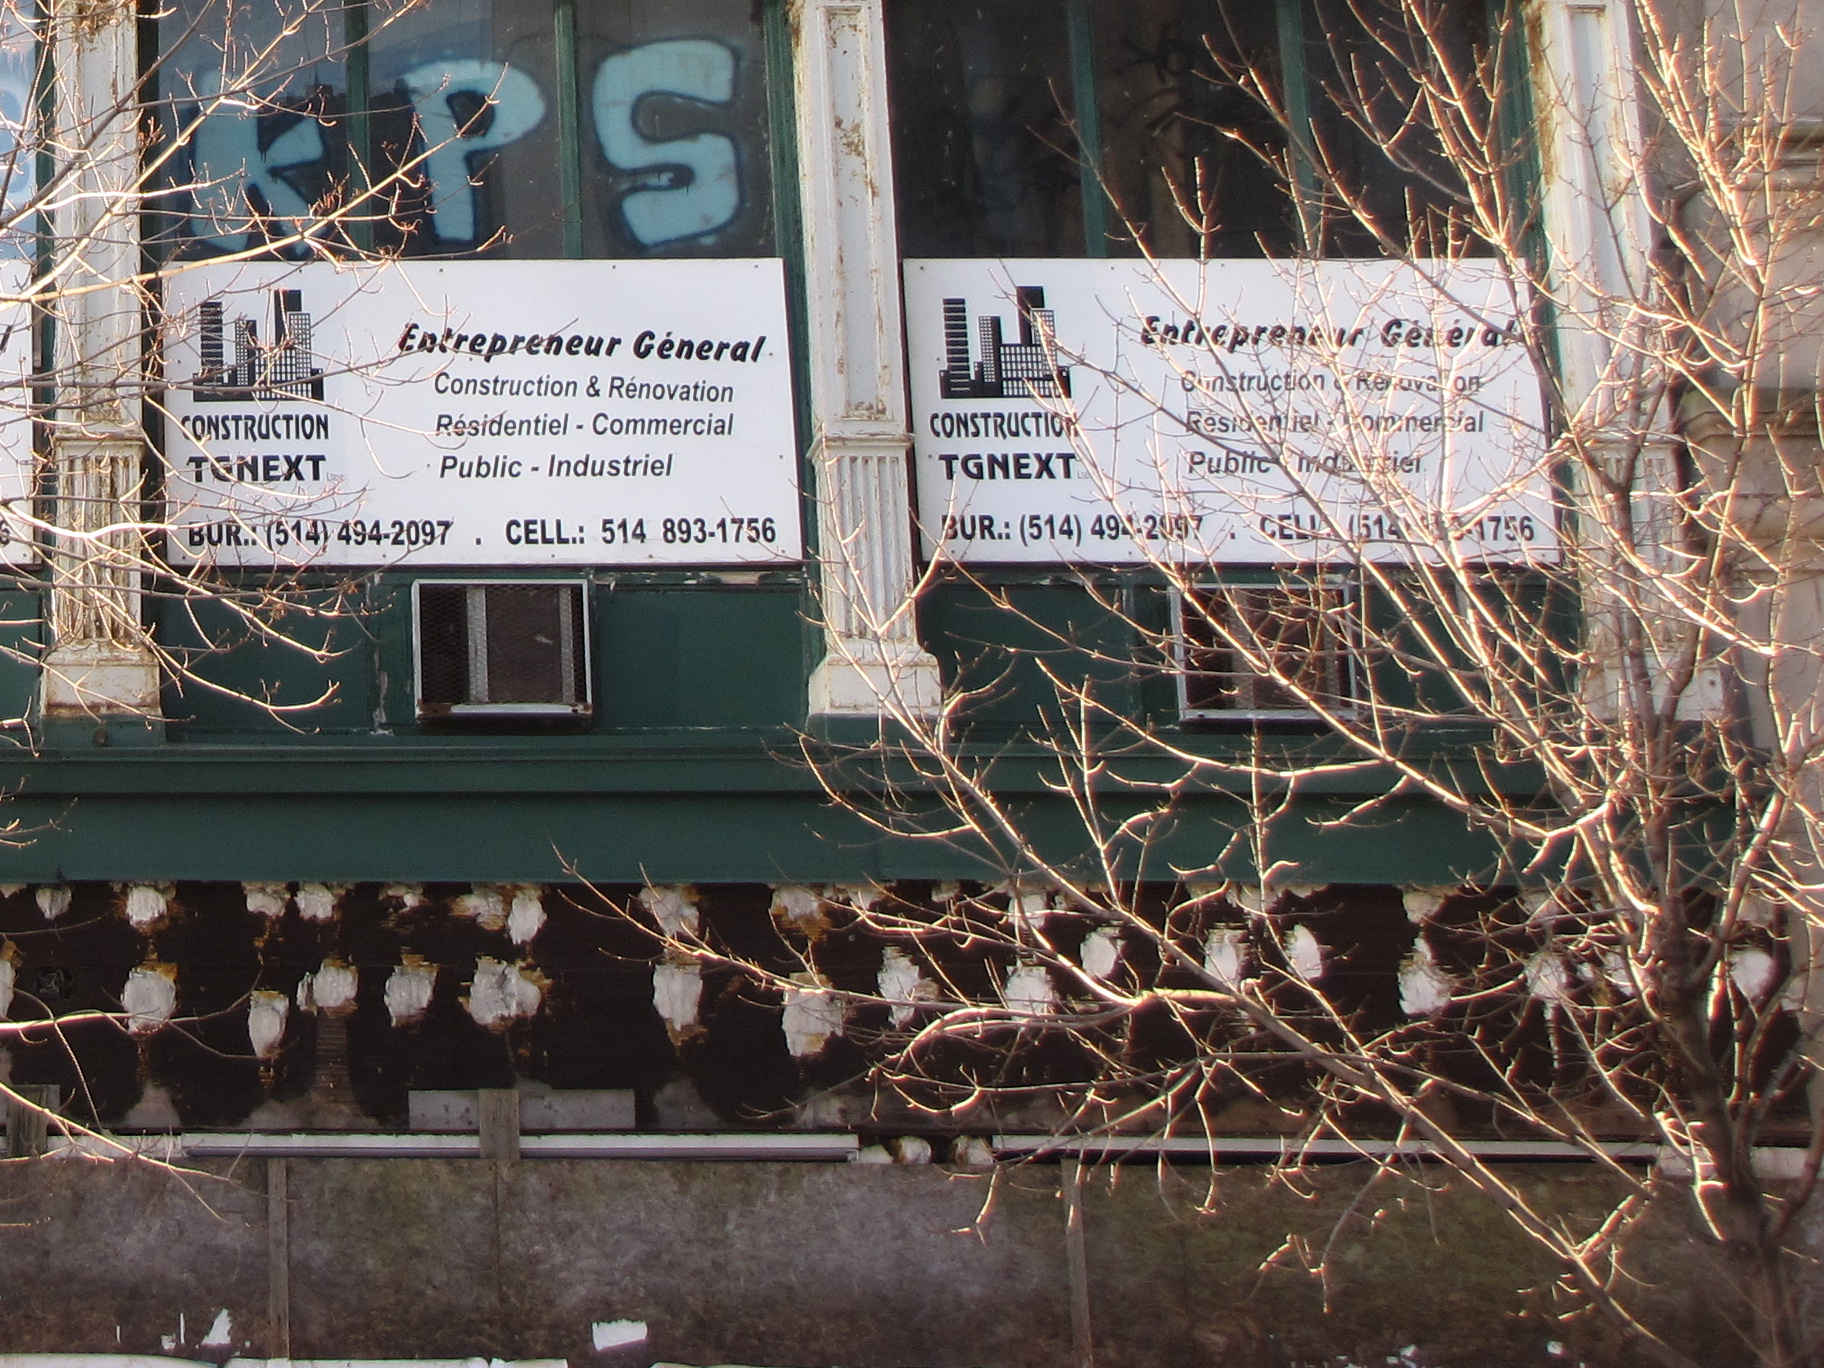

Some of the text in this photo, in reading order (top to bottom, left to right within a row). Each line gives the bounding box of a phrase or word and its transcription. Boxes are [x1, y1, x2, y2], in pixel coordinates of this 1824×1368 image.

[398, 323, 621, 362] Entrepreneur
[435, 372, 734, 403] Construction & Rénovation
[1356, 369, 1481, 392] Réovaon
[181, 413, 329, 443] CONSTRUCTION
[435, 413, 569, 437] Résidentiel
[592, 412, 734, 436] Commercial
[1343, 411, 1484, 434] ommerial
[187, 455, 326, 482] TGNEXT
[440, 455, 522, 479] Public
[548, 454, 673, 478] Industriel
[938, 453, 1075, 480] TGNEXT
[1188, 451, 1271, 474] Public
[188, 520, 258, 547] BUR.:
[266, 520, 327, 553] (514)
[337, 519, 452, 546] 494-2097
[505, 518, 585, 545] CELL.:
[601, 517, 647, 544] 514
[662, 517, 776, 544] 893-1756
[941, 514, 1011, 541] BUR.:
[1019, 513, 1082, 547] (514)
